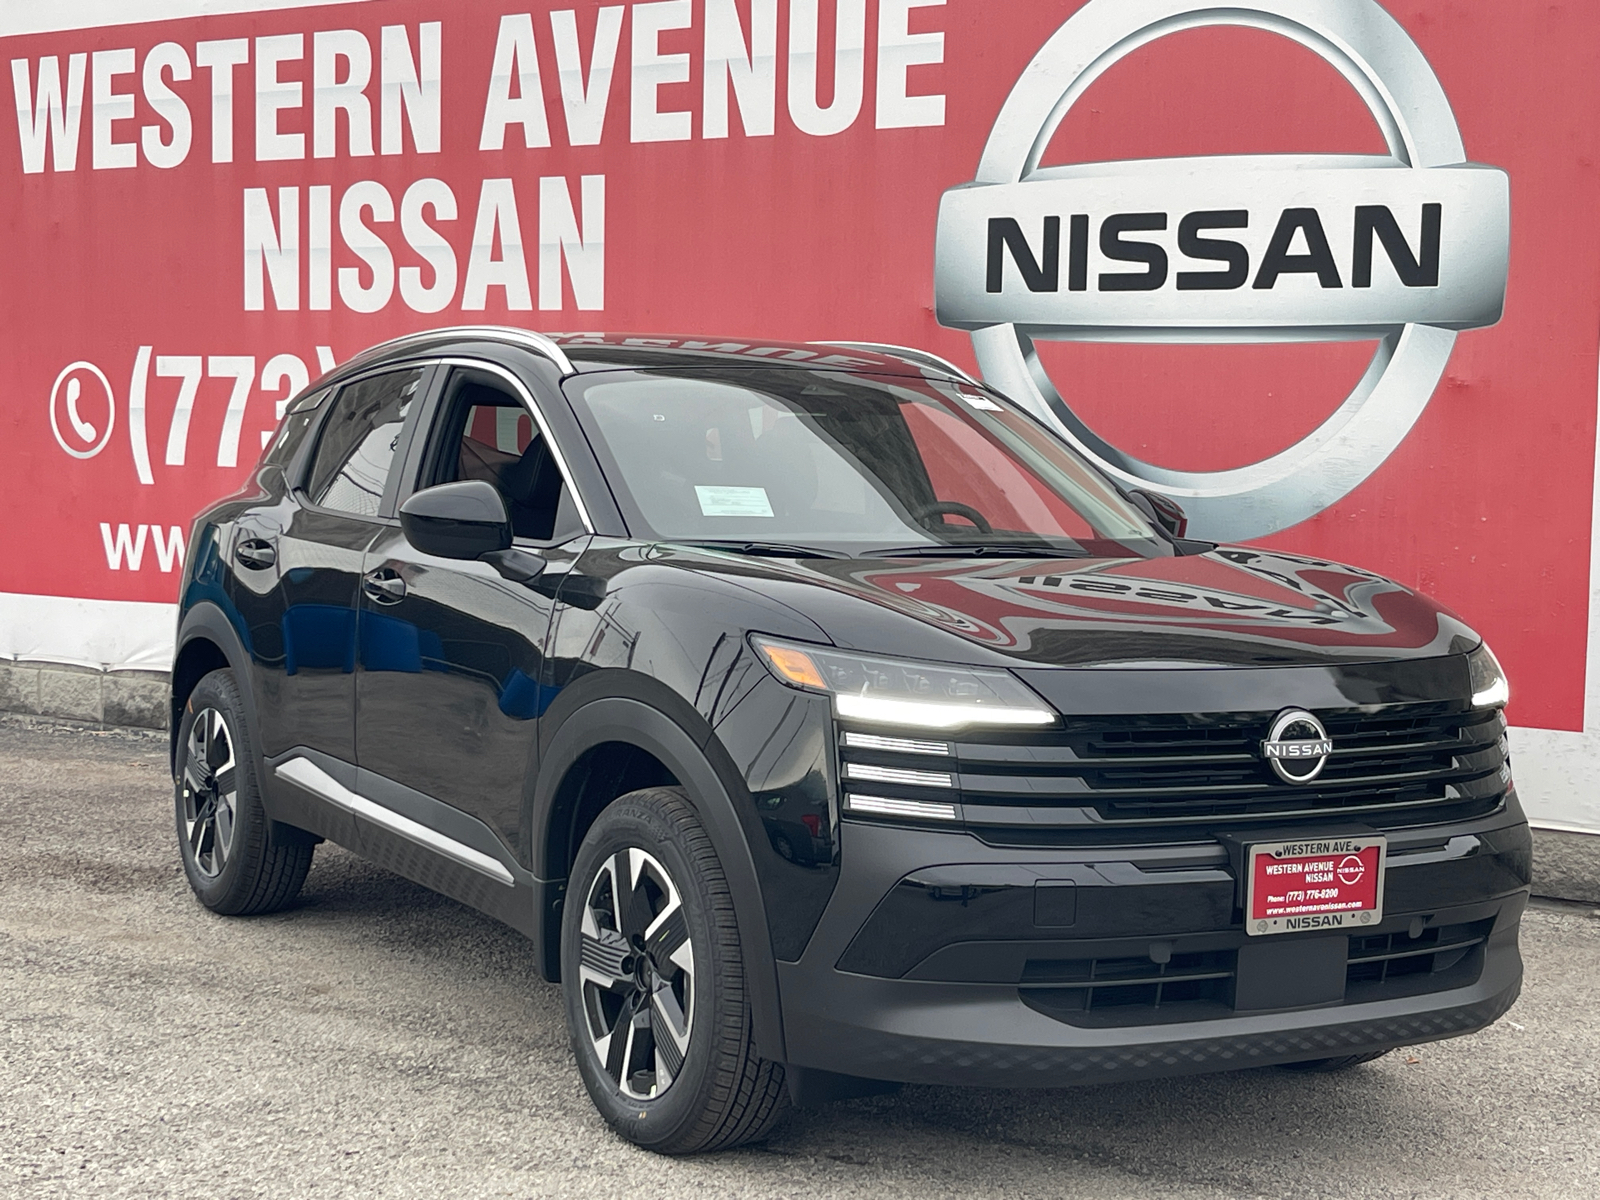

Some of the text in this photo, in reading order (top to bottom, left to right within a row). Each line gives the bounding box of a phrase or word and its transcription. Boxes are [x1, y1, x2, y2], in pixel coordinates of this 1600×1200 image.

[11, 0, 947, 174] WESTERN AVENUE
[243, 174, 606, 314] NISSAN
[986, 203, 1442, 293] NISSAN
[129, 346, 337, 484] (773
[1266, 741, 1332, 757] NISSAN
[1283, 842, 1330, 856] WESTERN
[1266, 861, 1334, 875] WESTERN AVENUE
[1306, 872, 1334, 883] NISSAN
[1286, 890, 1304, 903] (773)
[1306, 888, 1338, 899] 776-8200
[1286, 914, 1343, 929] NISSAN
